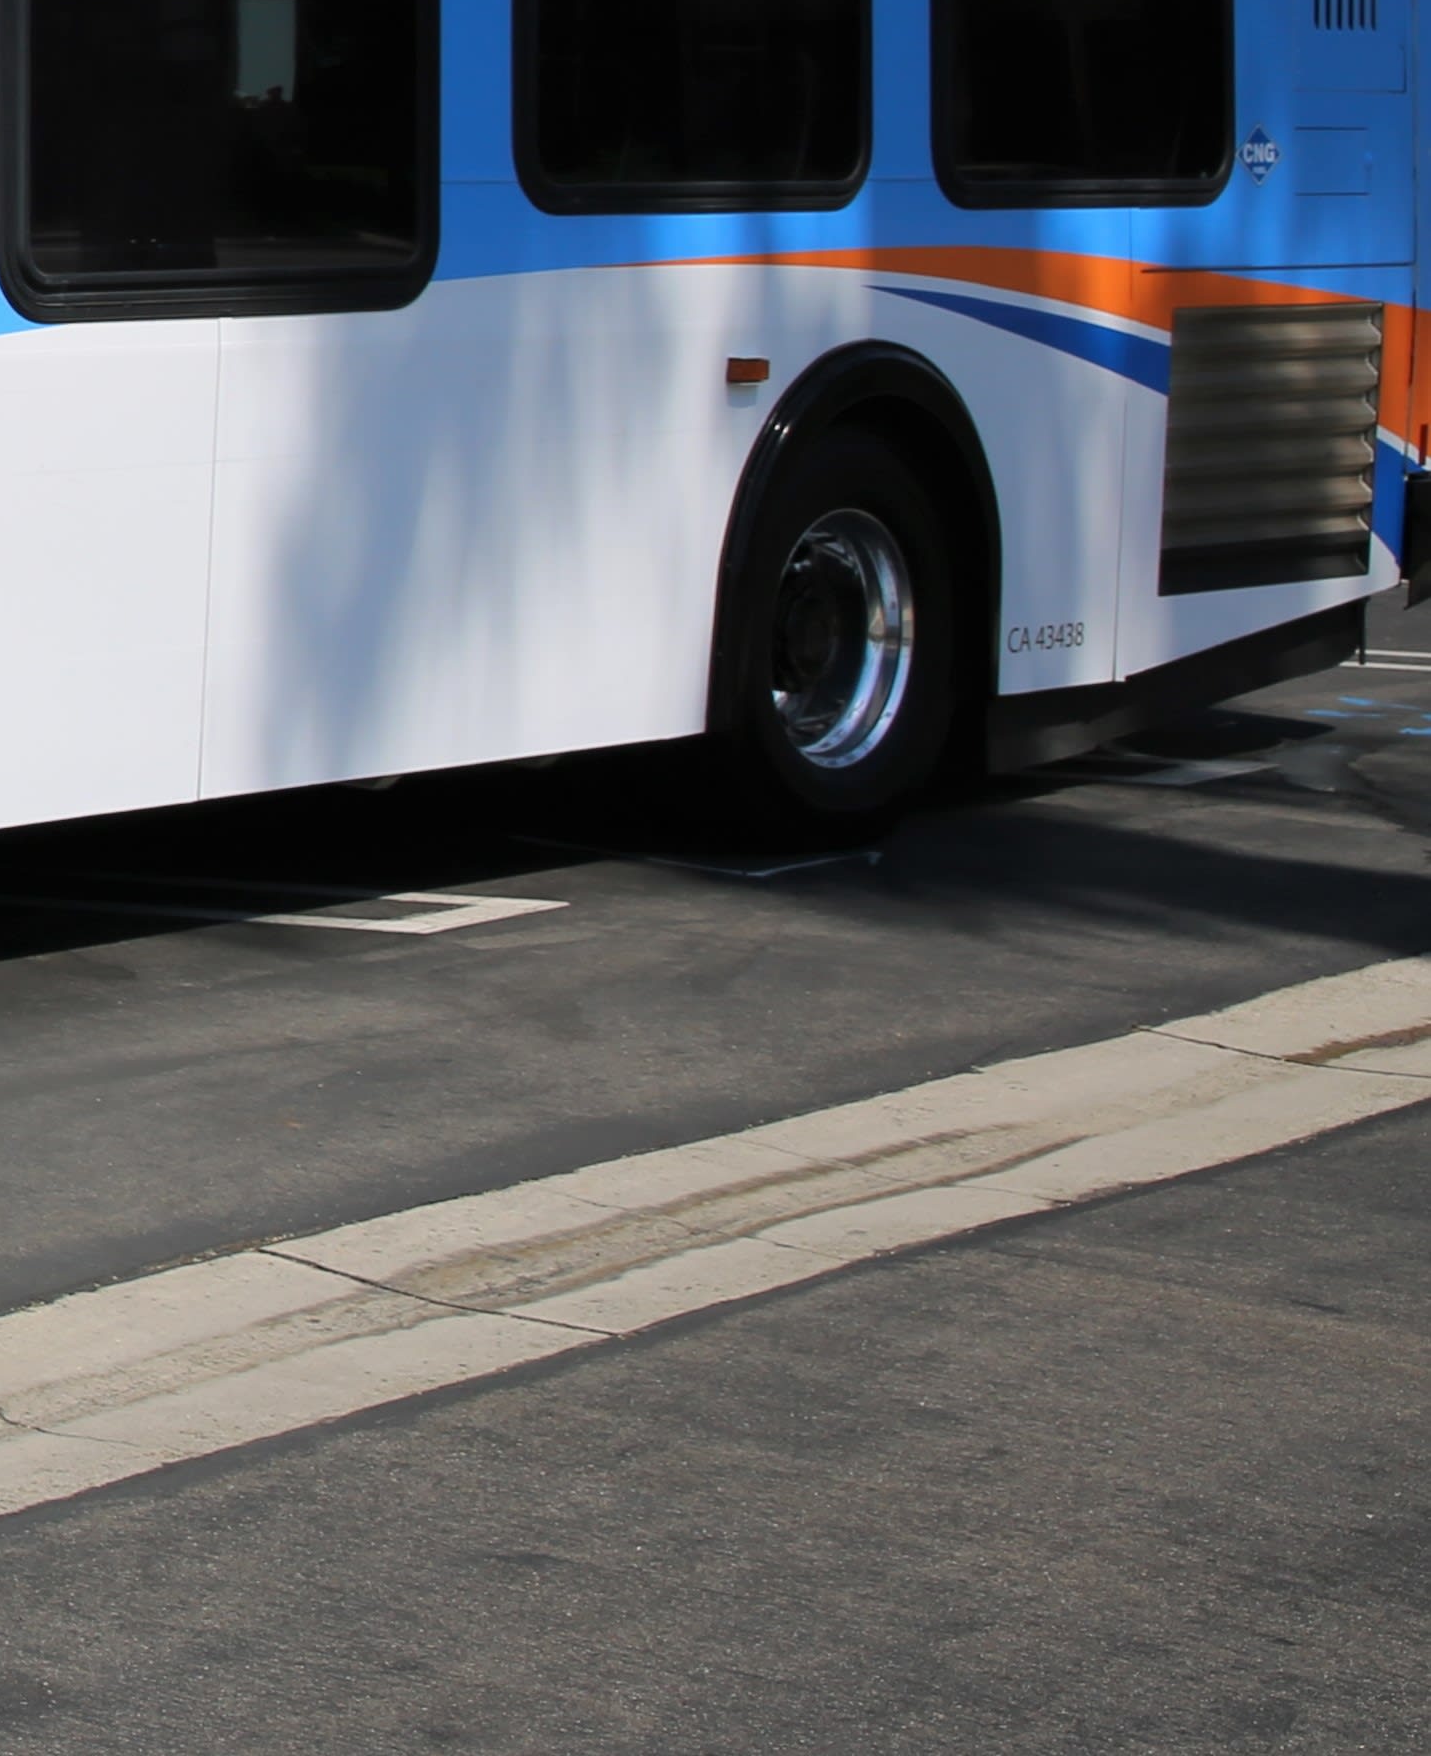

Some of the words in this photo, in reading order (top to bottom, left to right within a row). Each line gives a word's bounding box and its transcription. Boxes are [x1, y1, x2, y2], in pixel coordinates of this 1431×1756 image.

[1243, 143, 1276, 163] CNG
[1007, 626, 1032, 654] CA
[1035, 622, 1085, 651] 43438
